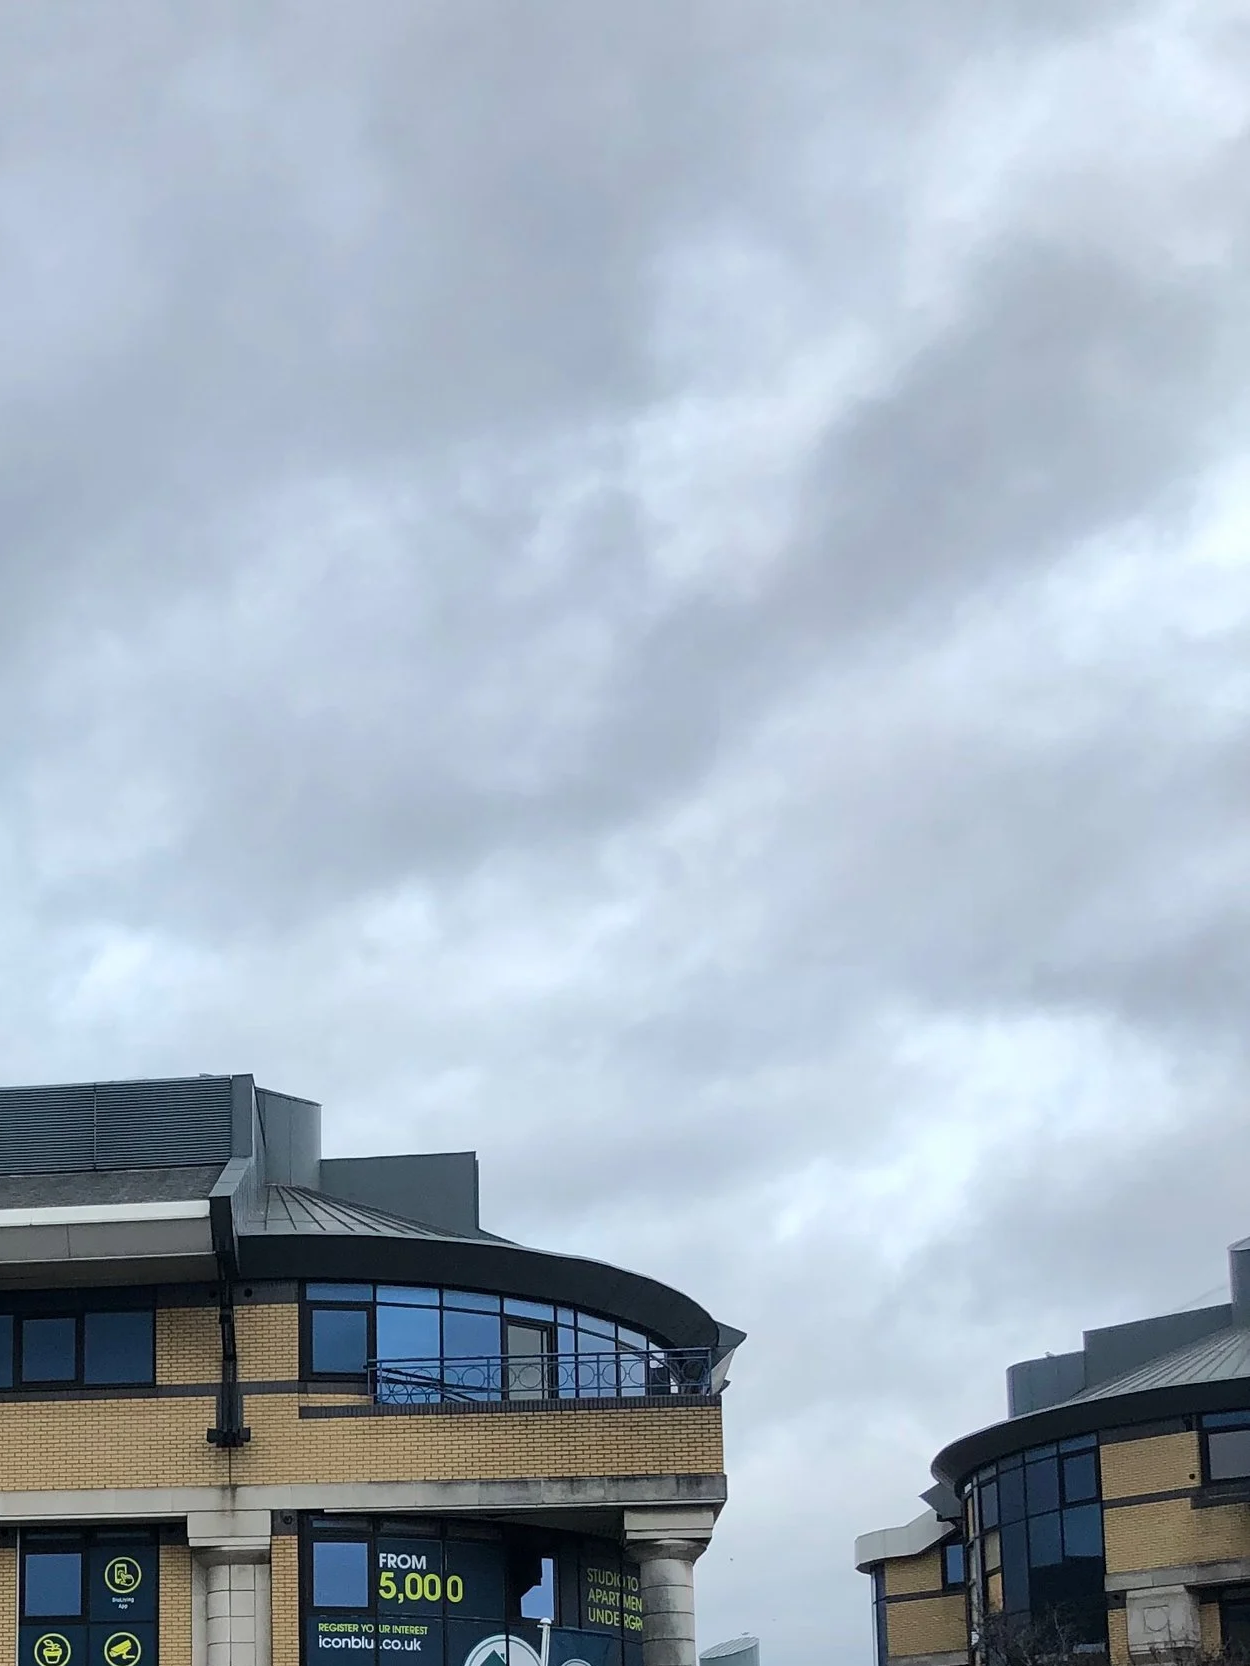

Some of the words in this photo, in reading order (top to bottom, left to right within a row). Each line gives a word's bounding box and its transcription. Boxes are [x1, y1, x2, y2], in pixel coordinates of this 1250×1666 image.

[379, 1553, 426, 1570] FROM
[378, 1571, 464, 1603] 5,000
[318, 1623, 359, 1633] REGISTER
[392, 1625, 428, 1635] INTEREST
